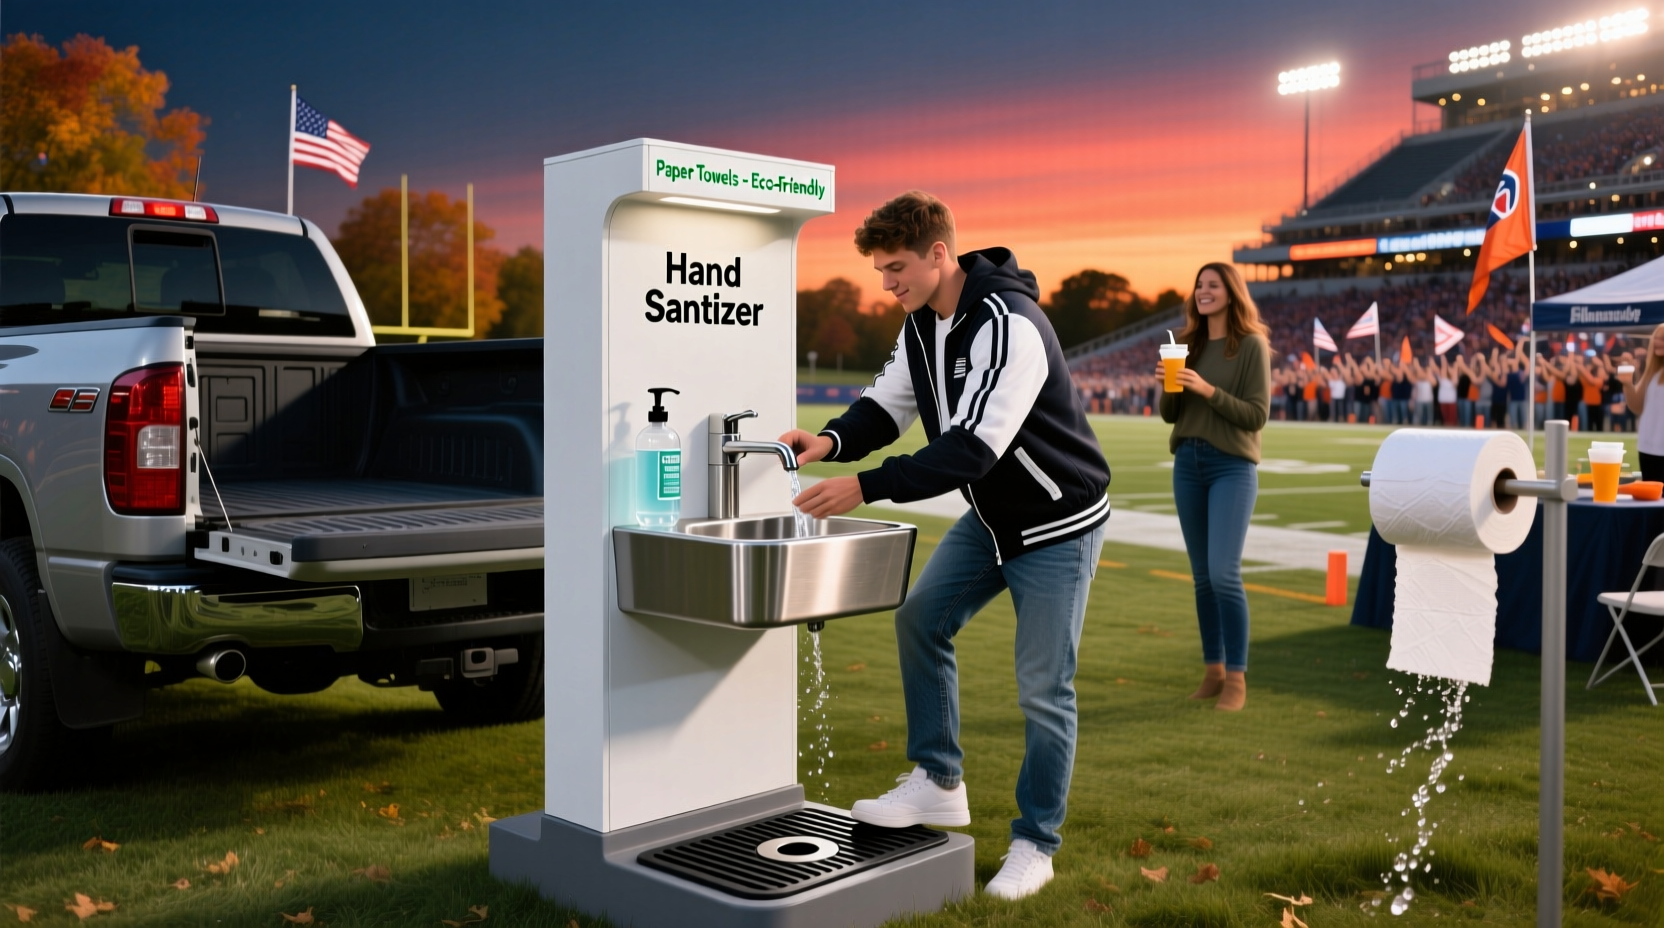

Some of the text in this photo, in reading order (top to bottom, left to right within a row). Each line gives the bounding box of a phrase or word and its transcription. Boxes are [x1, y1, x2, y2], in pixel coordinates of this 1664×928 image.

[656, 159, 694, 182] Paper
[696, 164, 739, 187] Towels
[751, 172, 825, 200] Eco-Friendly
[666, 251, 741, 288] Hand
[645, 288, 764, 326] Santizer
